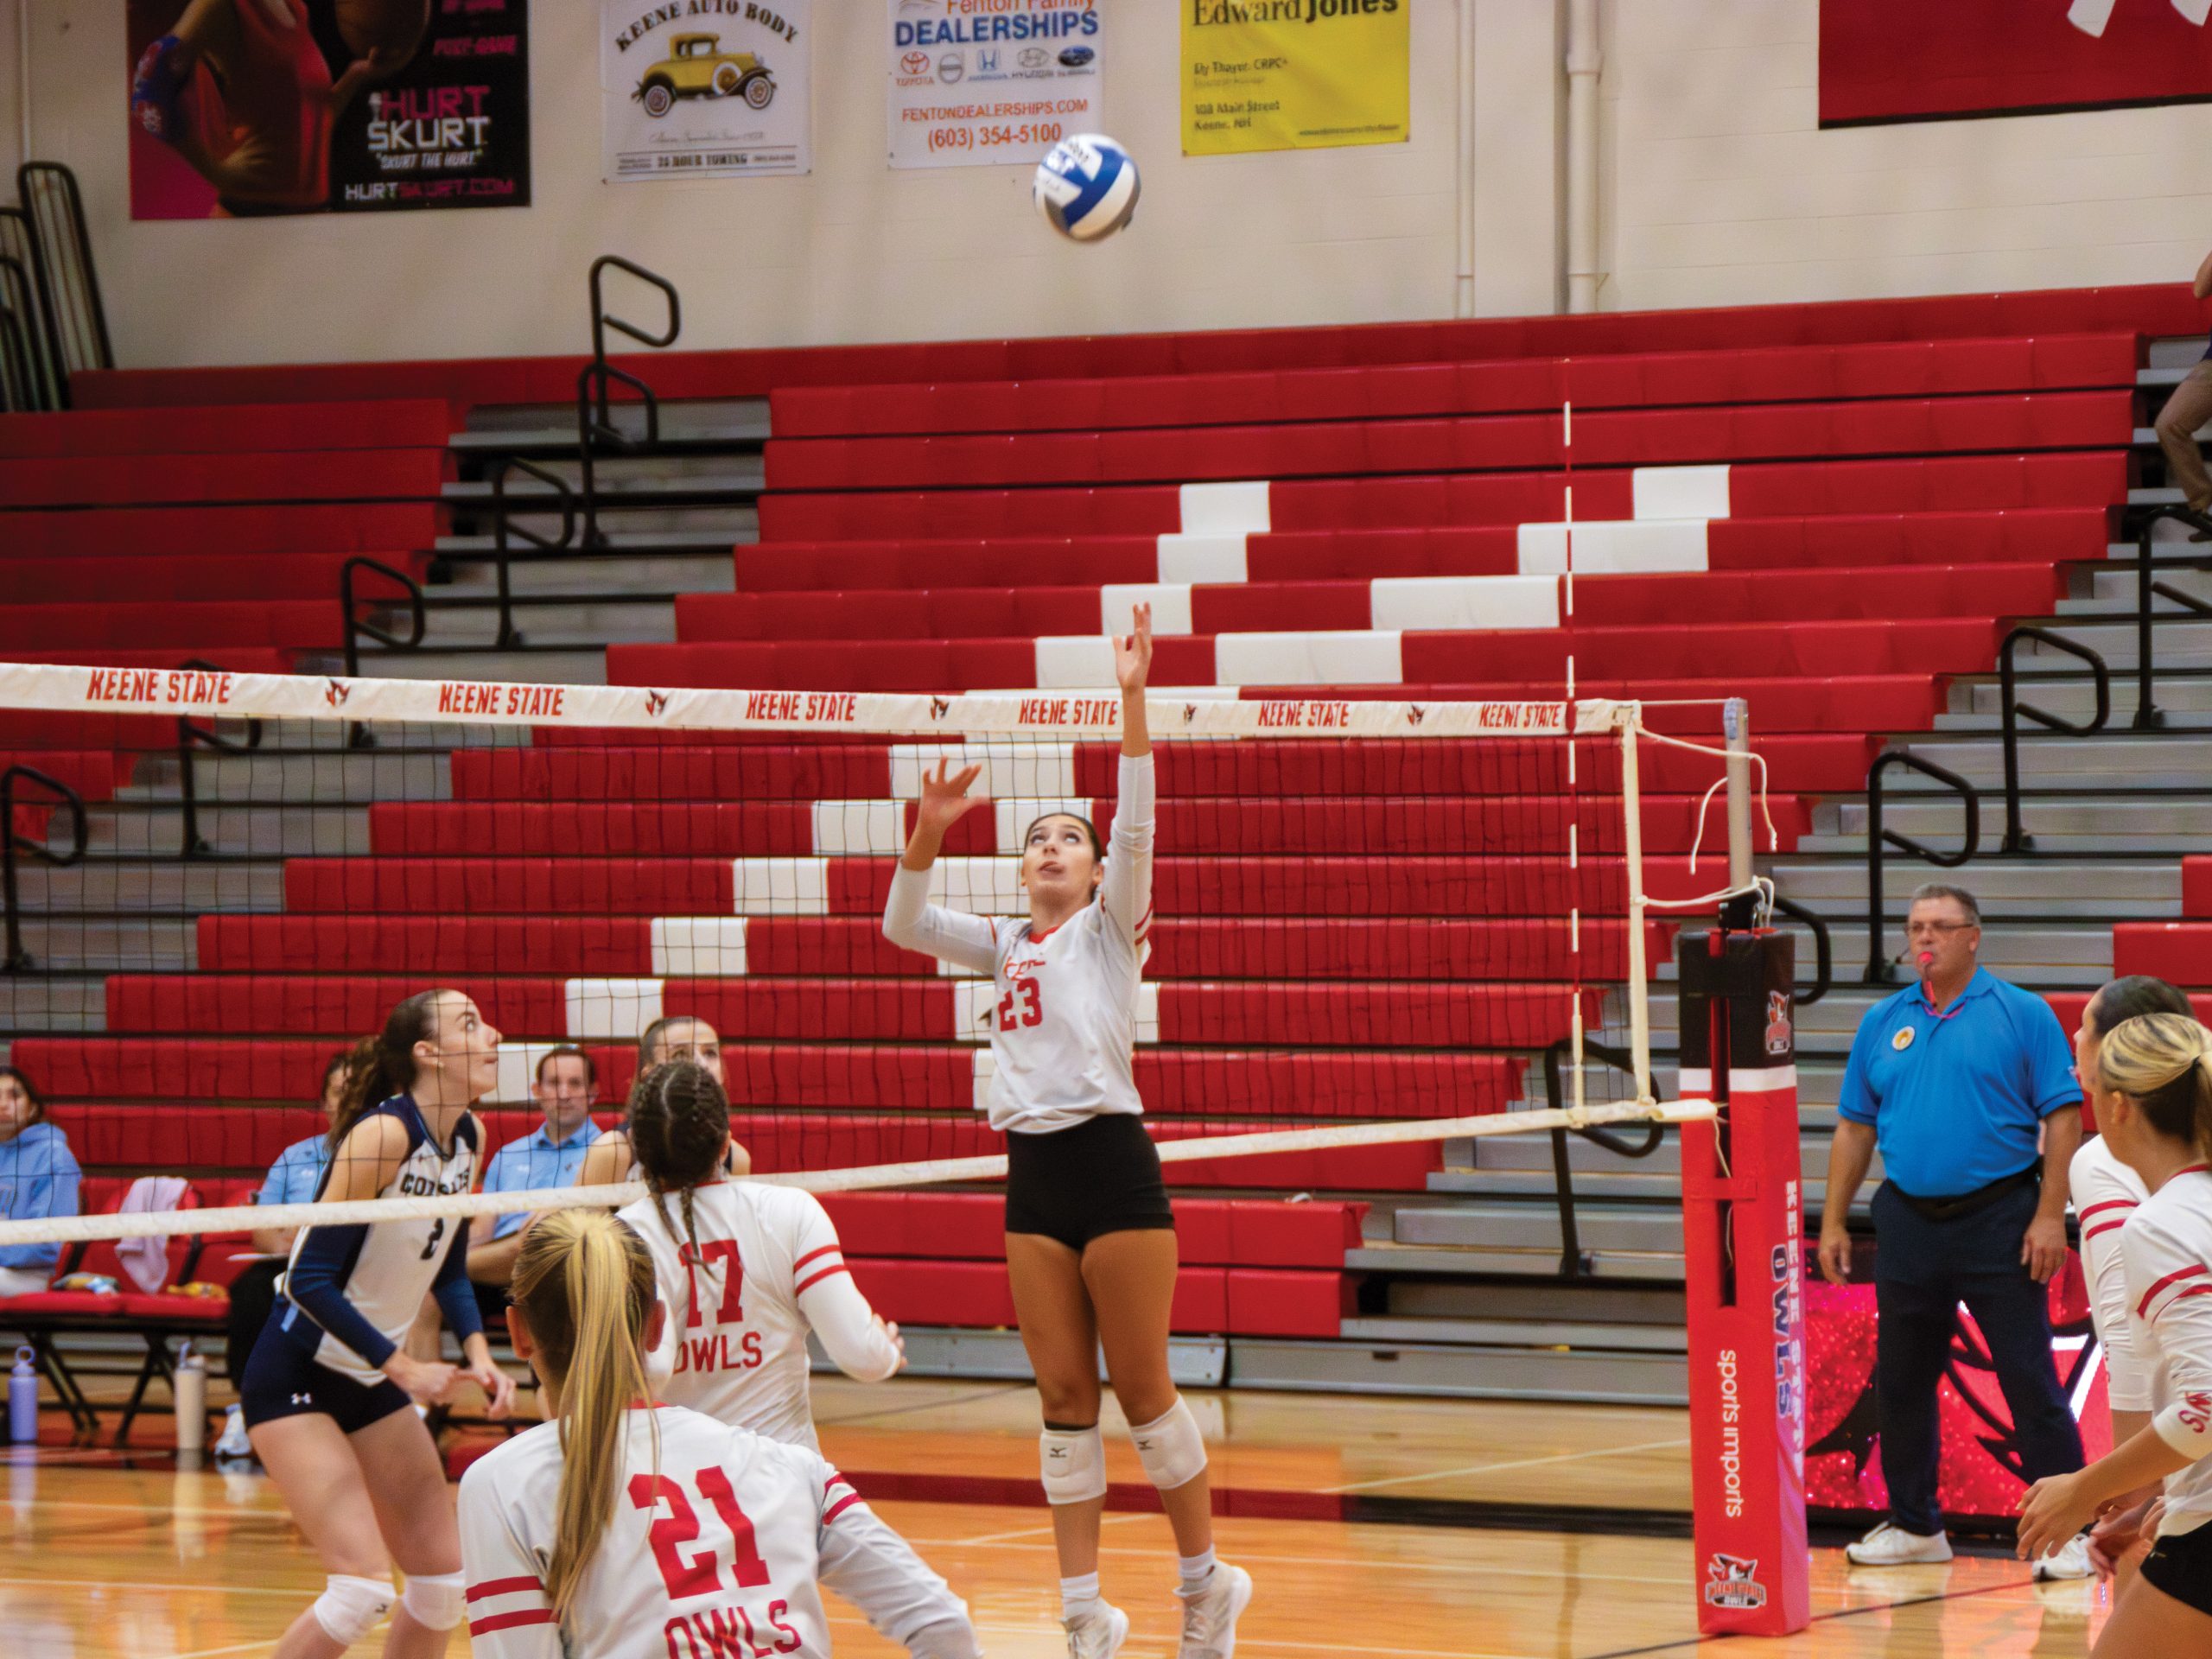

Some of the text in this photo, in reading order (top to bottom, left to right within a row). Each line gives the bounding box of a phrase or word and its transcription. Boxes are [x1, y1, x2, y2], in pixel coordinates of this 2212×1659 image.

[947, 0, 1020, 14] Fenton
[1193, 0, 1398, 26] Edward Jones
[616, 0, 798, 53] KEENE AUTO BODY
[895, 10, 1099, 46] DEALERSHIPS
[381, 86, 492, 119] HURT
[902, 99, 1089, 123] FENTONDEALERSHIPS.COM
[367, 116, 493, 151] SKURT
[927, 123, 1063, 152] (603) 354-5100
[86, 669, 232, 705] KEENE STATE
[438, 683, 565, 716] KEENE STATE
[745, 693, 857, 722] KEENE STATE
[1019, 698, 1118, 726] KEENE STATE
[1257, 702, 1349, 728] KEENE STATE
[1523, 704, 1560, 728] STATE
[998, 976, 1044, 1032] 23
[419, 1217, 445, 1260] 2
[1785, 1179, 1801, 1323] KEENE
[677, 1238, 744, 1328] 17
[1772, 1244, 1792, 1420] OWLS
[1717, 1349, 1745, 1518] sports imports
[627, 1465, 772, 1601] 21
[664, 1599, 802, 1659] OWLS
